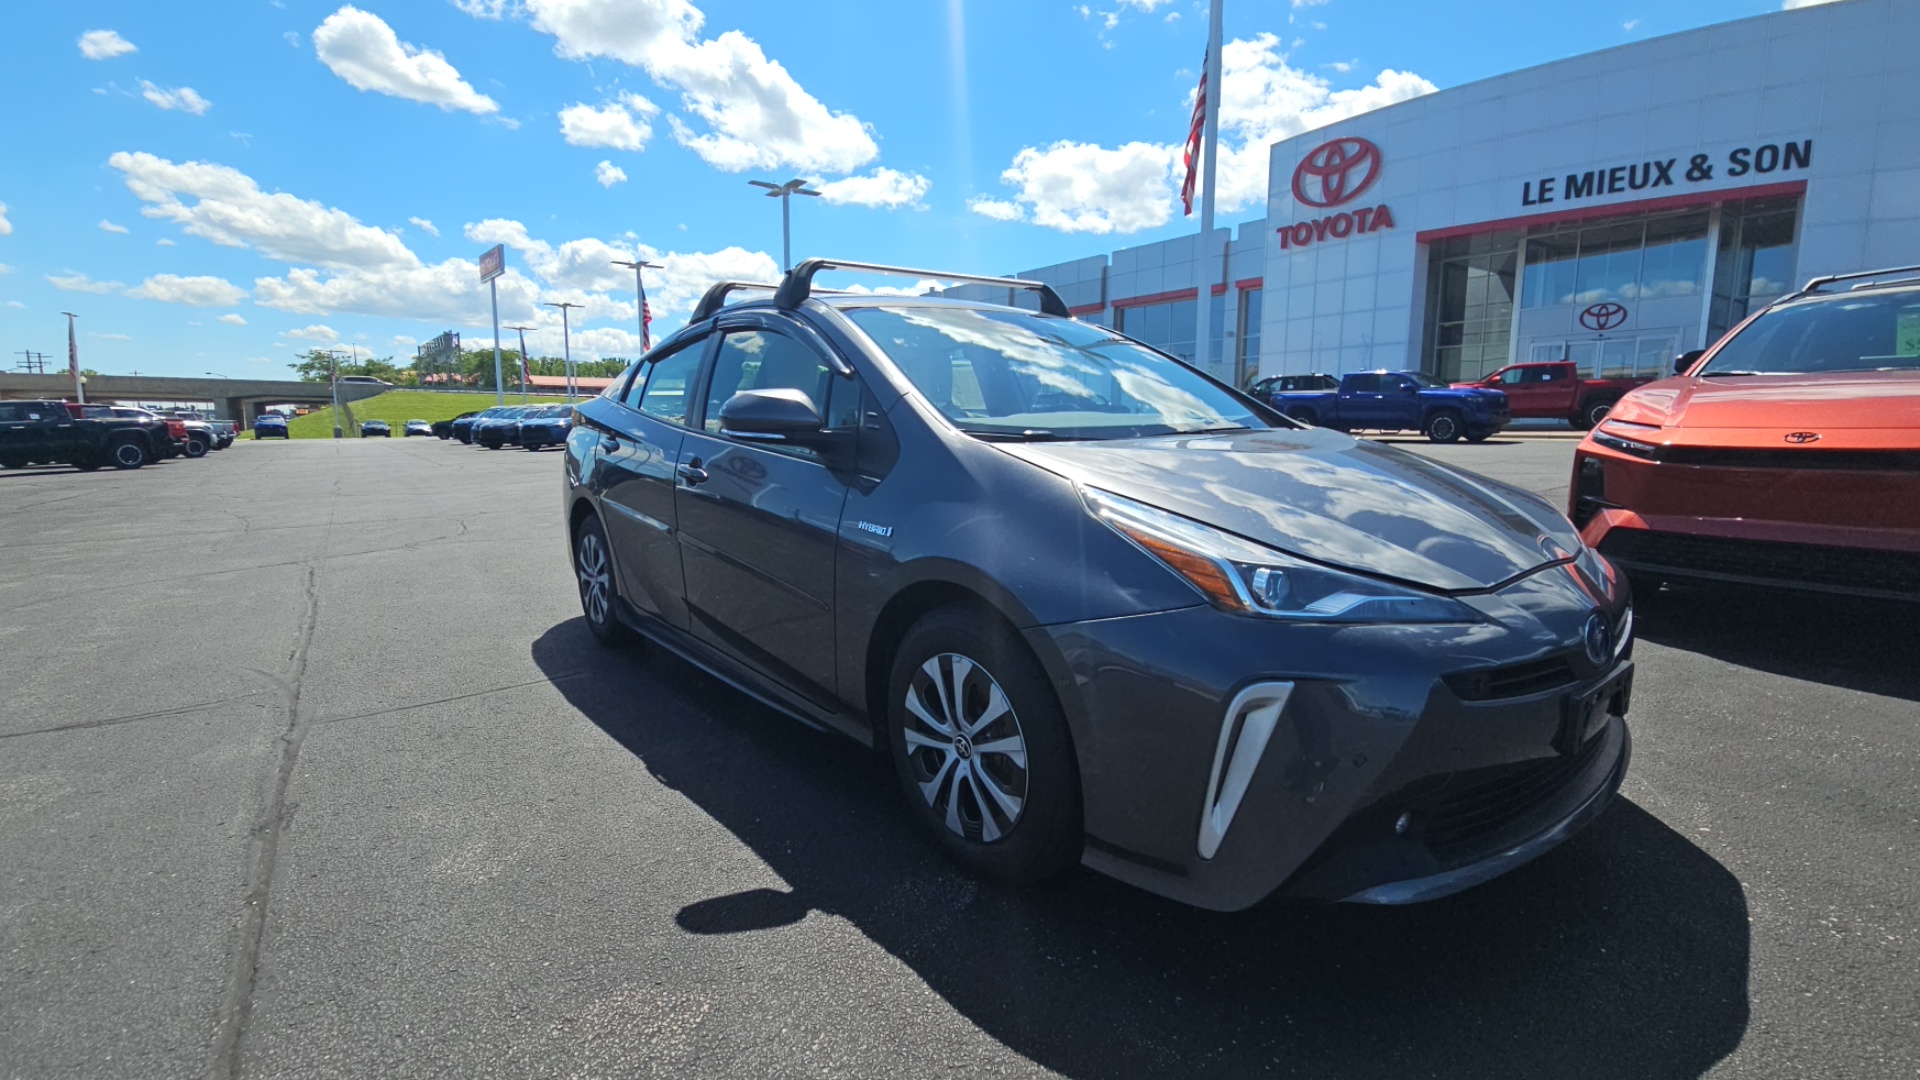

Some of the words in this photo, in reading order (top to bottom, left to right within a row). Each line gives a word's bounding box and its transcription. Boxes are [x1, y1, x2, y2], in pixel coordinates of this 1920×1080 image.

[1522, 177, 1555, 206] LE
[1564, 158, 1676, 200] MIEUX
[1685, 153, 1713, 182] &
[1727, 139, 1812, 177] SON
[1277, 204, 1394, 249] TOYOTA
[858, 520, 887, 536] HYBRID
